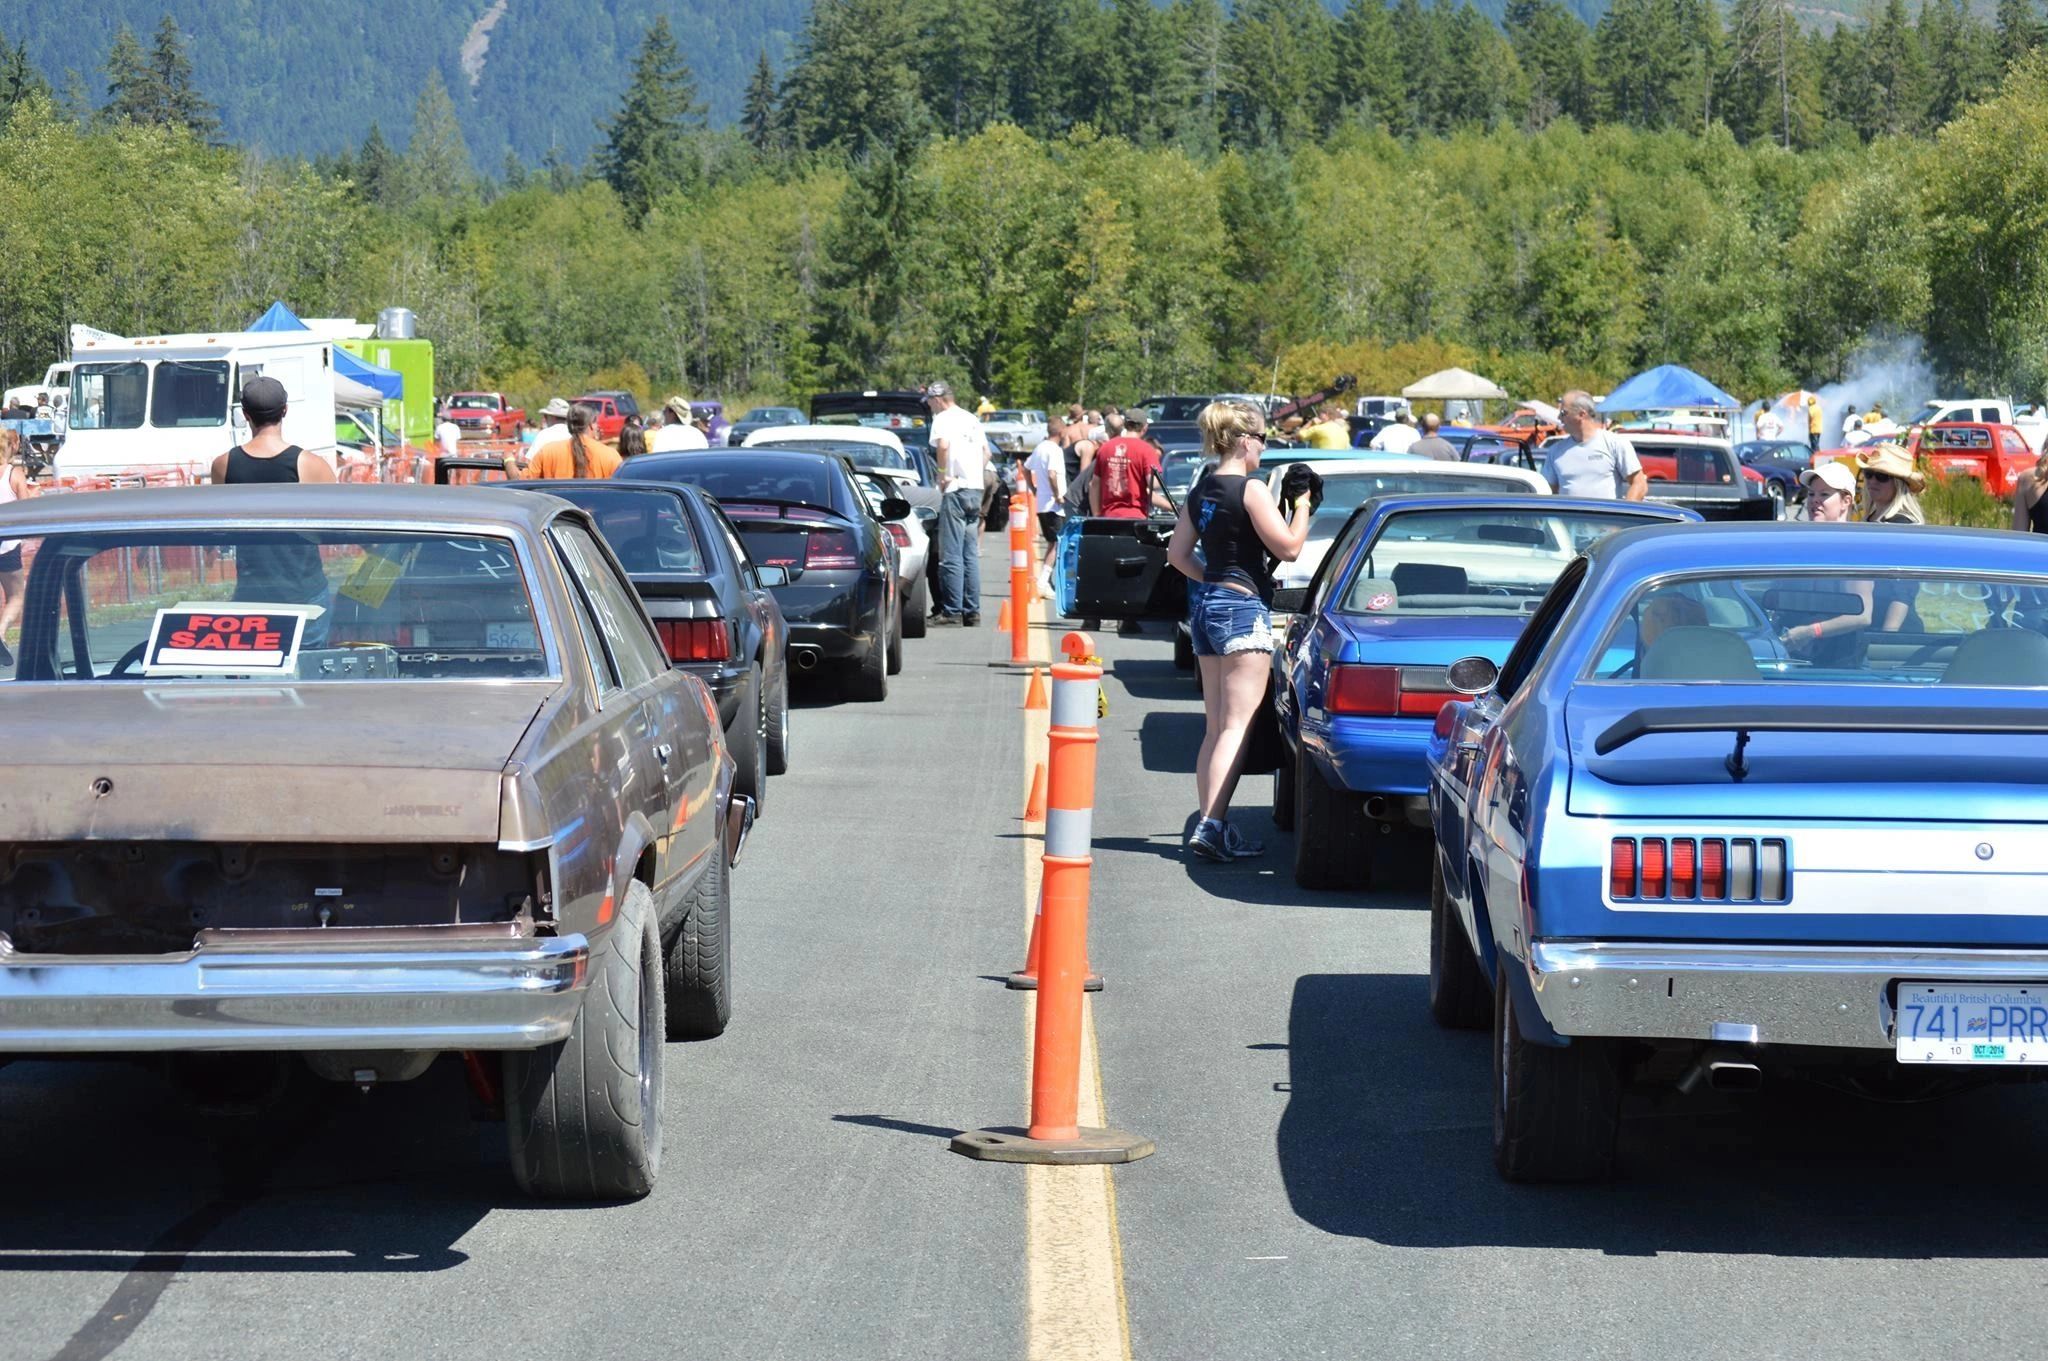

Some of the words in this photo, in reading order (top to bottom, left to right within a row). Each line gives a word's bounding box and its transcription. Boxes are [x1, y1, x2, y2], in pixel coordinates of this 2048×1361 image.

[187, 615, 269, 633] FOR
[169, 631, 281, 650] SALE
[1911, 993, 1957, 1004] Beautiful
[1959, 994, 1991, 1004] British
[1992, 993, 2042, 1005] Columbia
[1905, 1005, 1960, 1042] 741
[1988, 1005, 2048, 1043] PRR
[1950, 1046, 1962, 1055] 10
[1973, 1045, 1986, 1055] OCT
[1989, 1045, 2005, 1055] 2014
